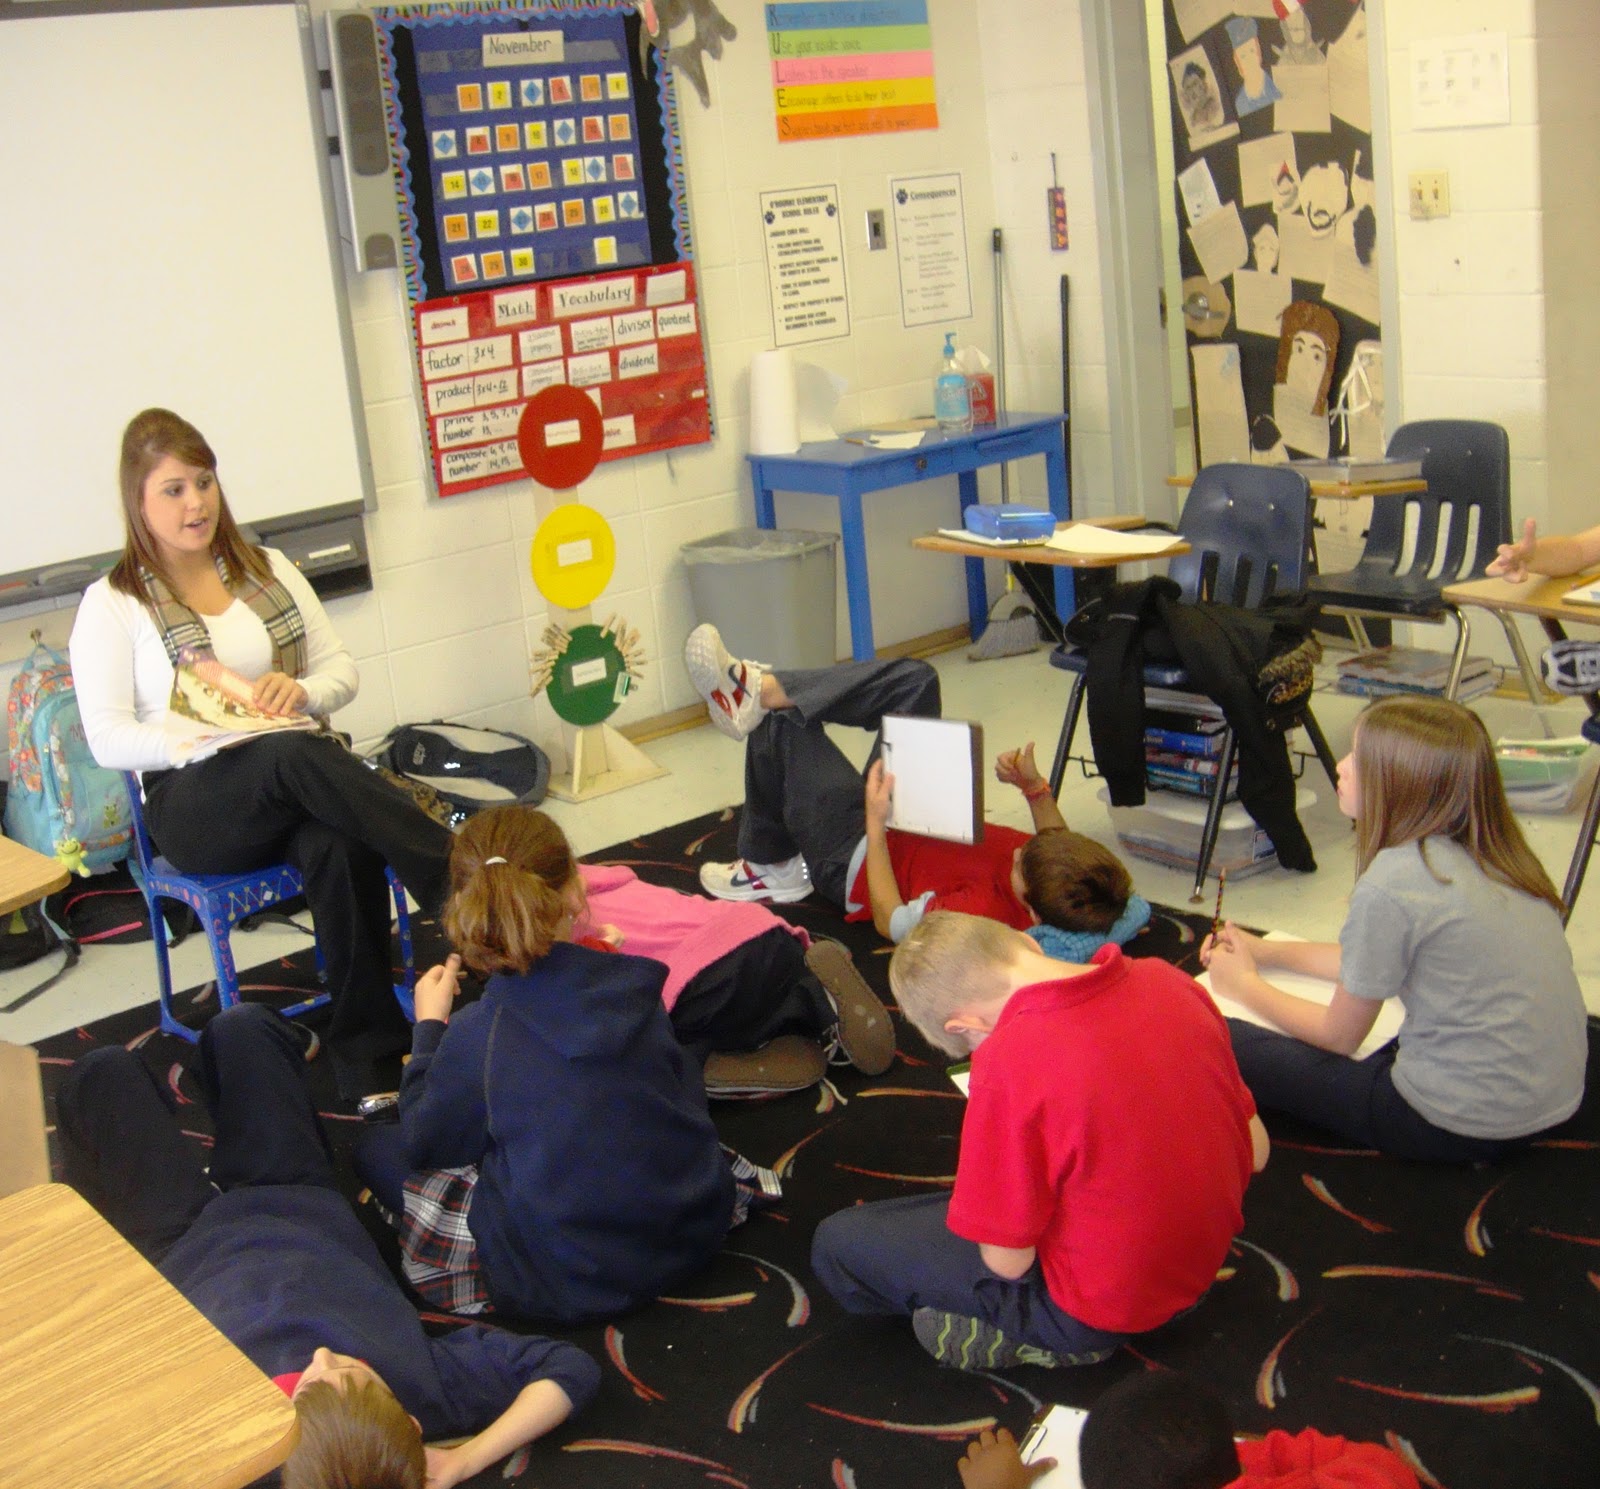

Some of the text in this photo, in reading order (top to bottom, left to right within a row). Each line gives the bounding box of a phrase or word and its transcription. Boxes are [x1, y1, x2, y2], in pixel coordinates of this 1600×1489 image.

[489, 33, 552, 56] November
[910, 189, 956, 200] Consequences
[451, 222, 463, 233] 21
[482, 218, 493, 230] 22
[497, 285, 632, 318] Math Vocabulary
[617, 318, 652, 336] divisor
[658, 311, 692, 333] quotient
[425, 350, 464, 371] factor
[620, 352, 655, 371] dividend
[435, 383, 472, 408] product
[443, 414, 474, 432] prime
[443, 426, 478, 442] number
[449, 460, 482, 478] number
